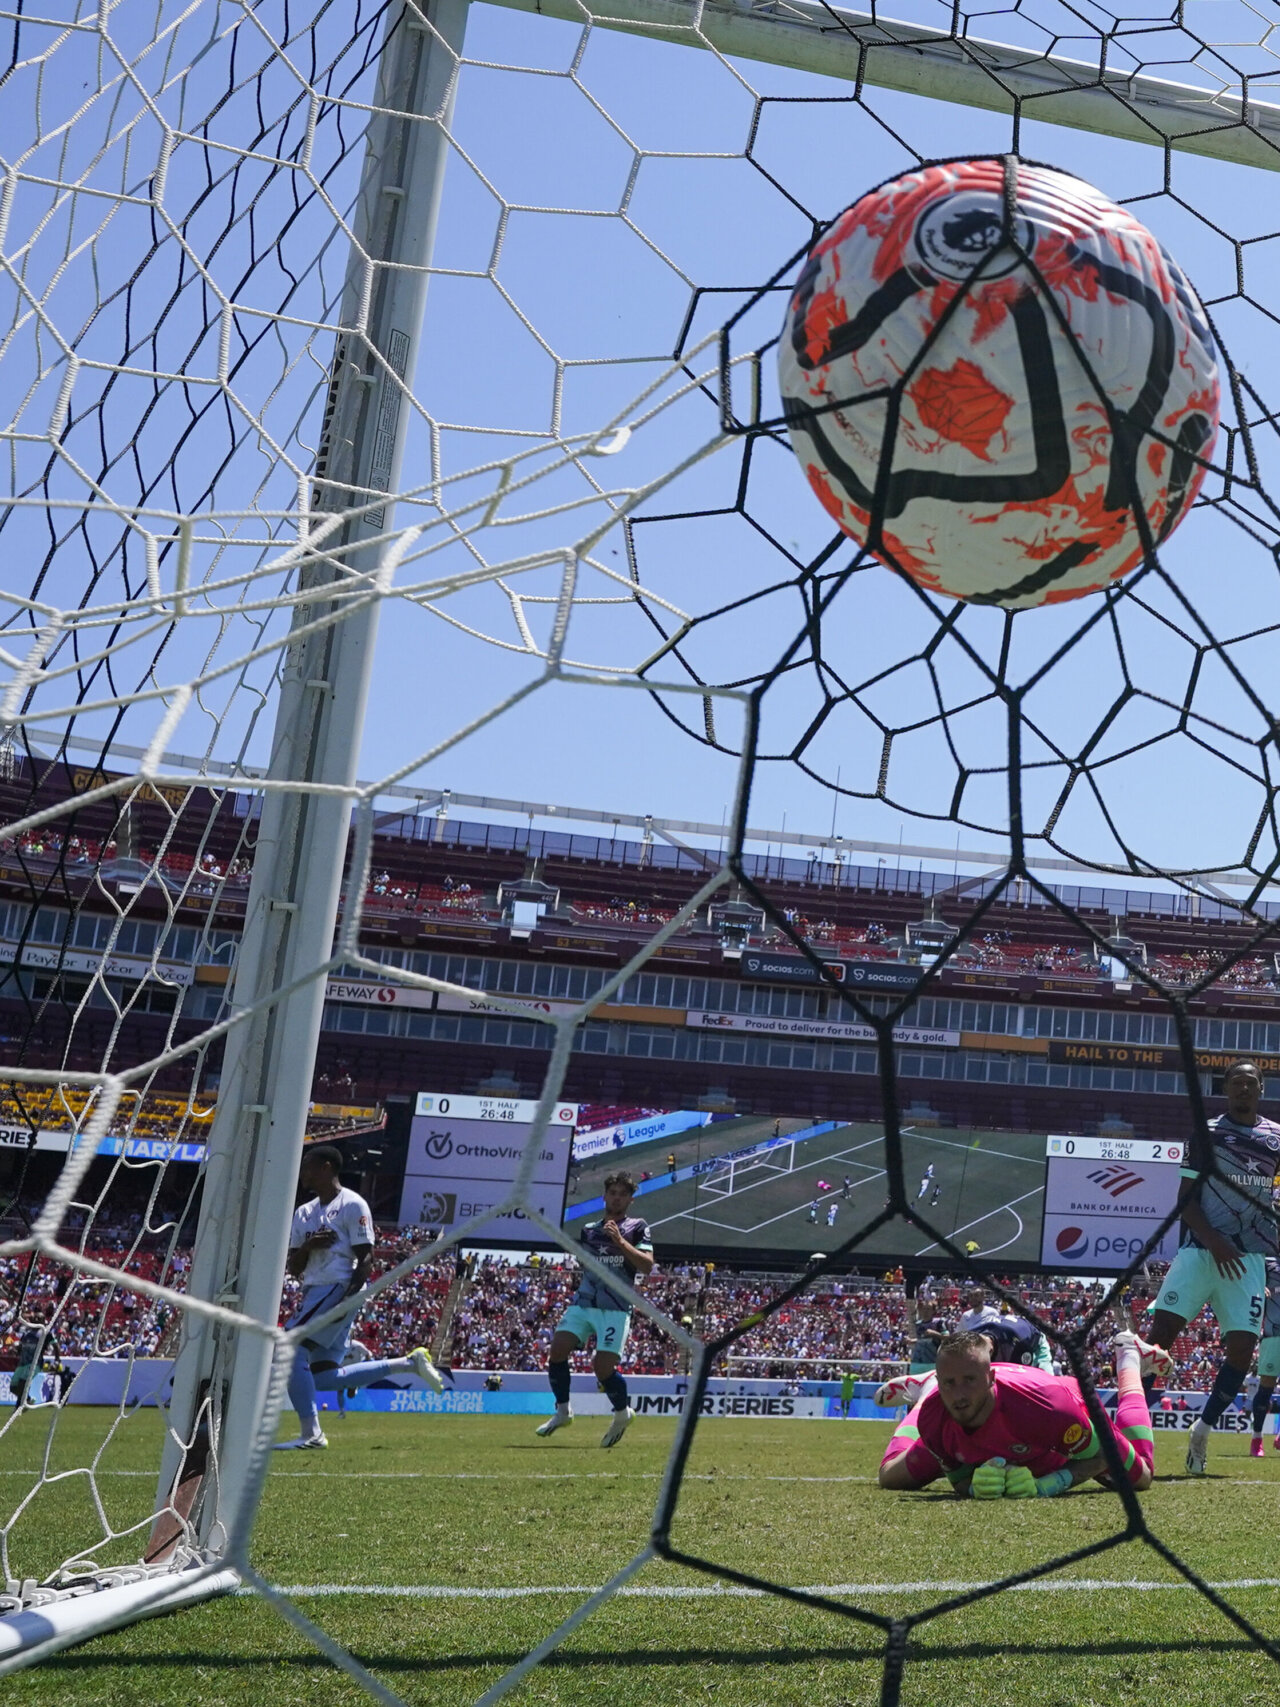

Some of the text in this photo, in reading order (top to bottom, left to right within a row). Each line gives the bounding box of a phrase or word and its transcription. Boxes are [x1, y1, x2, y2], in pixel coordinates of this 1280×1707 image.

[702, 1014, 734, 1027] FedEx
[745, 1019, 775, 1031] Proud
[778, 1021, 788, 1031] to
[790, 1022, 825, 1035] deliver
[827, 1025, 842, 1035] for
[845, 1026, 861, 1037] the
[922, 1032, 947, 1045] gold.
[1065, 1046, 1102, 1060] HAIL
[1108, 1048, 1128, 1061] TO
[1134, 1050, 1163, 1064] THE
[438, 1098, 450, 1114] 0
[479, 1100, 520, 1110] 1ST HALF
[480, 1108, 515, 1121] 26:48
[628, 1121, 666, 1140] League
[1065, 1140, 1075, 1155] 0
[1101, 1149, 1130, 1159] 26:48
[1152, 1144, 1162, 1159] 2
[1070, 1202, 1097, 1211] BANK
[1114, 1205, 1156, 1214] AMERICA
[1249, 1295, 1262, 1318] 5
[604, 1327, 616, 1342] 2
[393, 1390, 423, 1401] THE
[390, 1400, 484, 1412] STARTS HERE
[719, 1398, 795, 1416] SERIES
